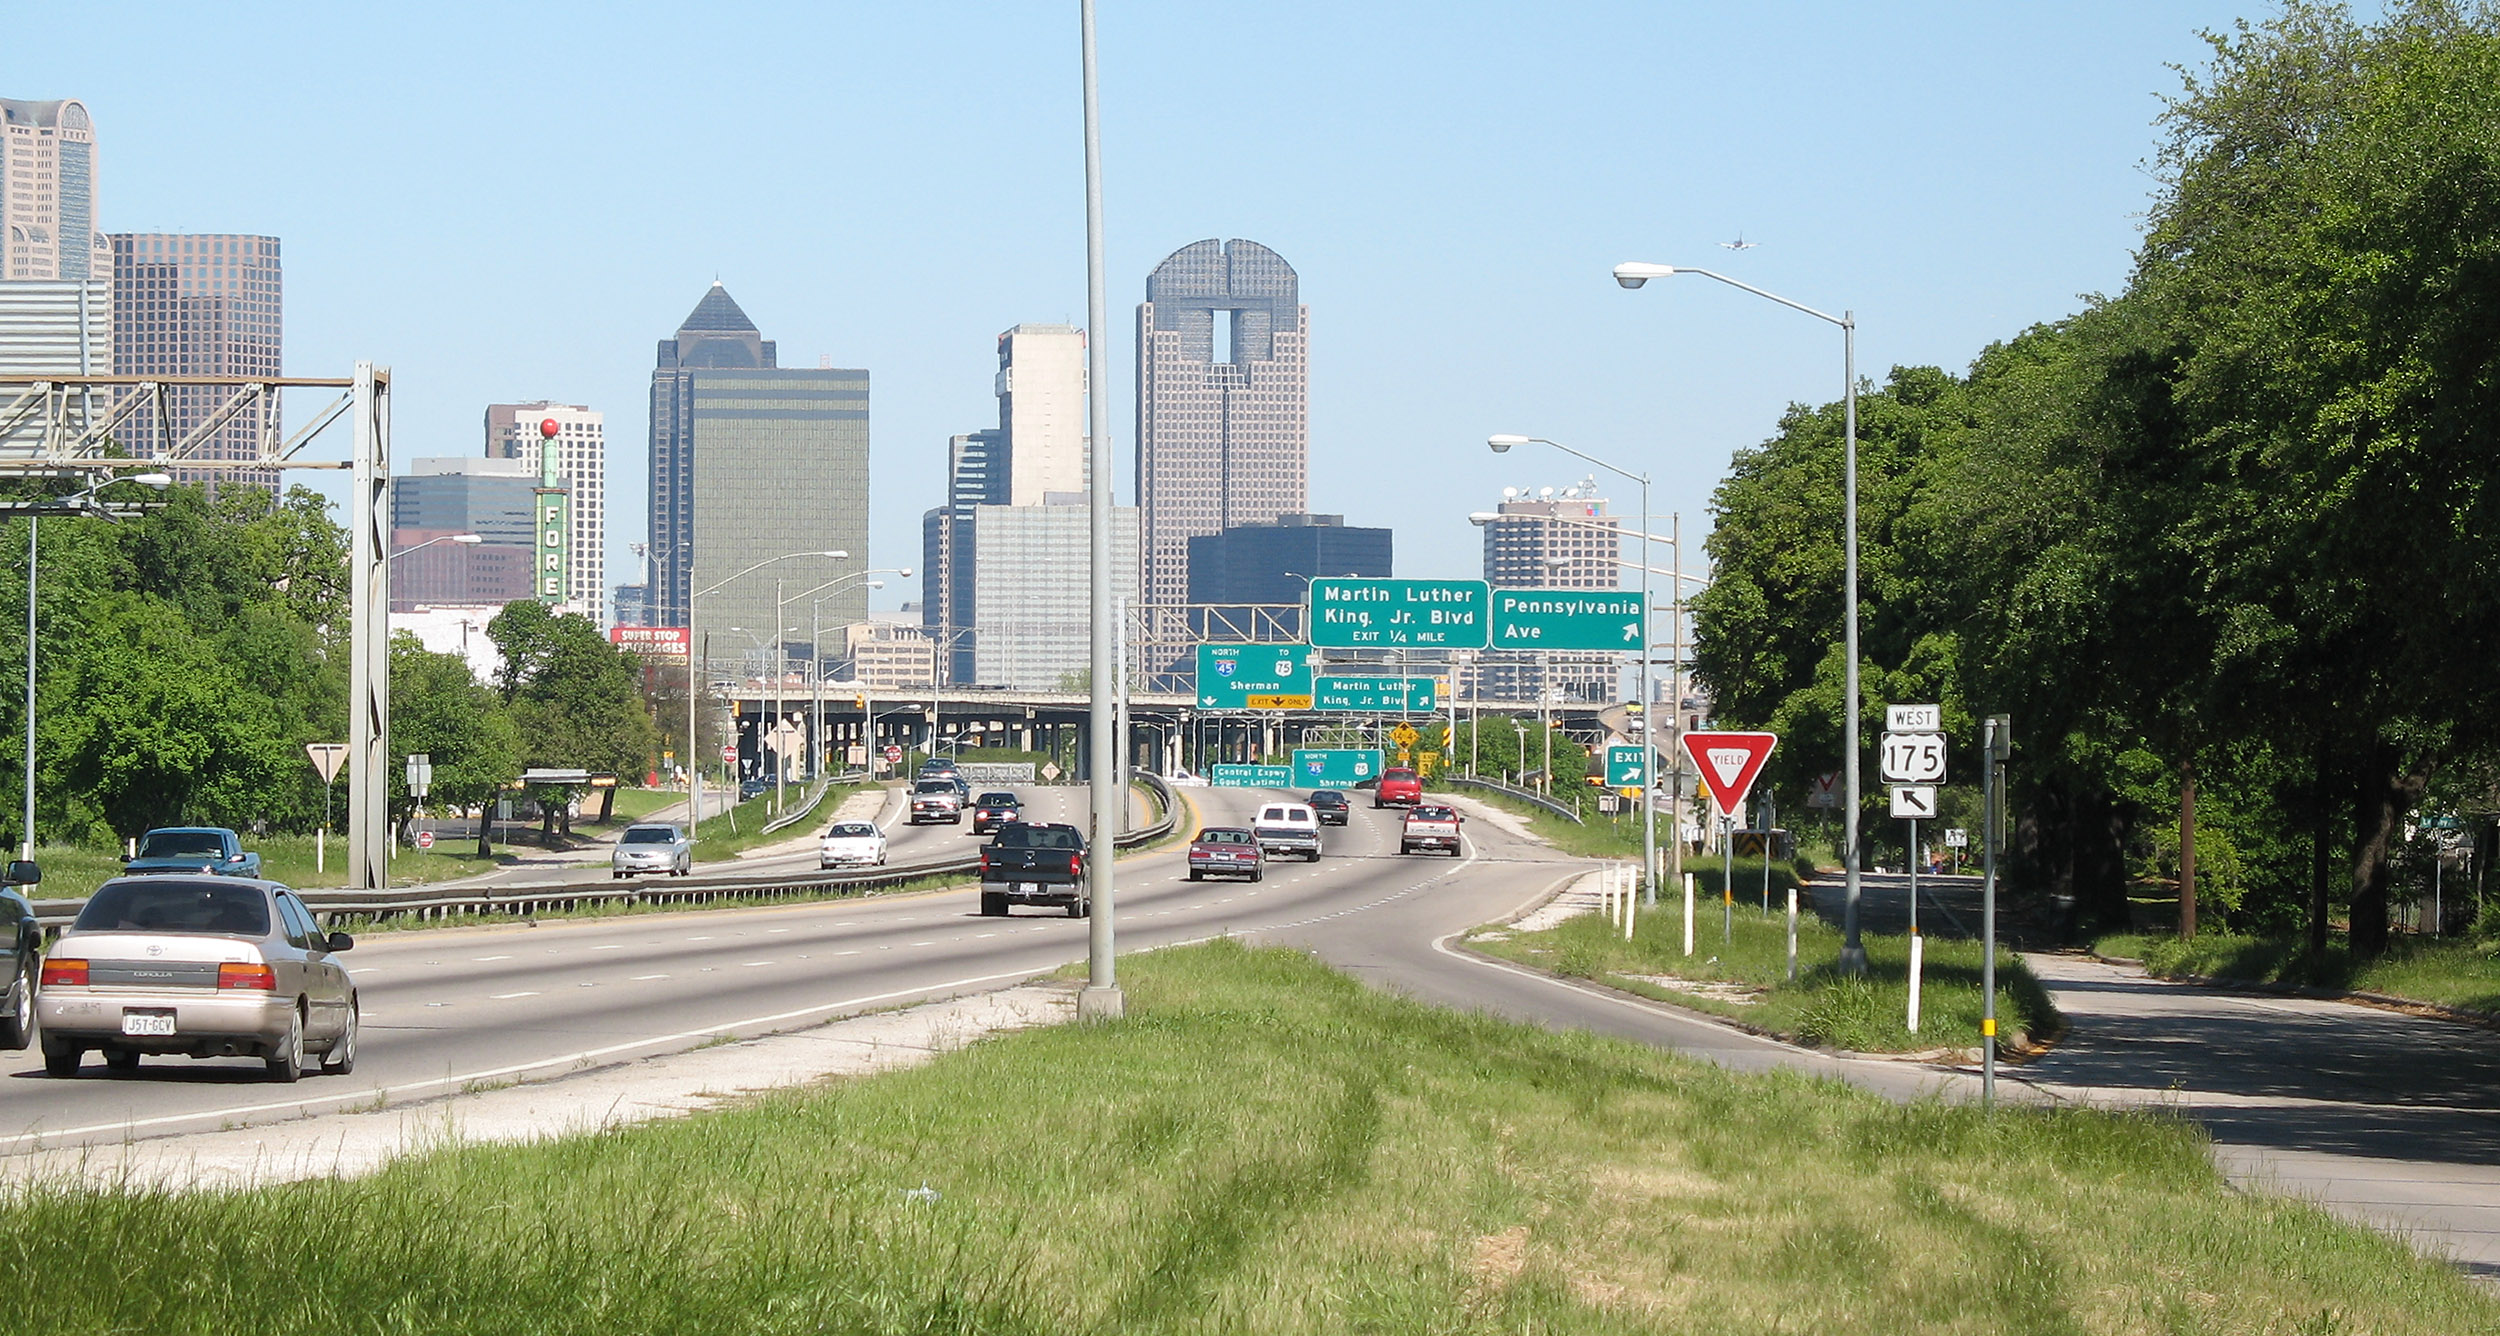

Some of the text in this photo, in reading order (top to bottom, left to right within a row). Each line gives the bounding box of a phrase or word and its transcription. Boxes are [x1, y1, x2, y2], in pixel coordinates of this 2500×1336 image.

[545, 506, 559, 595] FORE
[1325, 587, 1473, 602] Martin Luther
[1504, 598, 1640, 616] Pennsylvania
[1390, 610, 1416, 625] Jr.
[1431, 610, 1474, 625] Blvd
[621, 630, 681, 640] SUPER STOP
[1353, 631, 1380, 641] EXIT
[1417, 632, 1445, 642] MILE
[1505, 624, 1541, 638] Ave
[1211, 648, 1289, 656] NORTH TO
[1218, 663, 1290, 673] 45 75
[1230, 681, 1280, 690] Sherman
[1333, 682, 1416, 691] Martin Luther
[1360, 696, 1374, 705] Jr.
[1895, 711, 1932, 725] WEST
[1713, 755, 1745, 766] YIELD
[1890, 745, 1938, 772] 175
[1218, 768, 1286, 778] Central Expwy
[1356, 765, 1367, 773] 75
